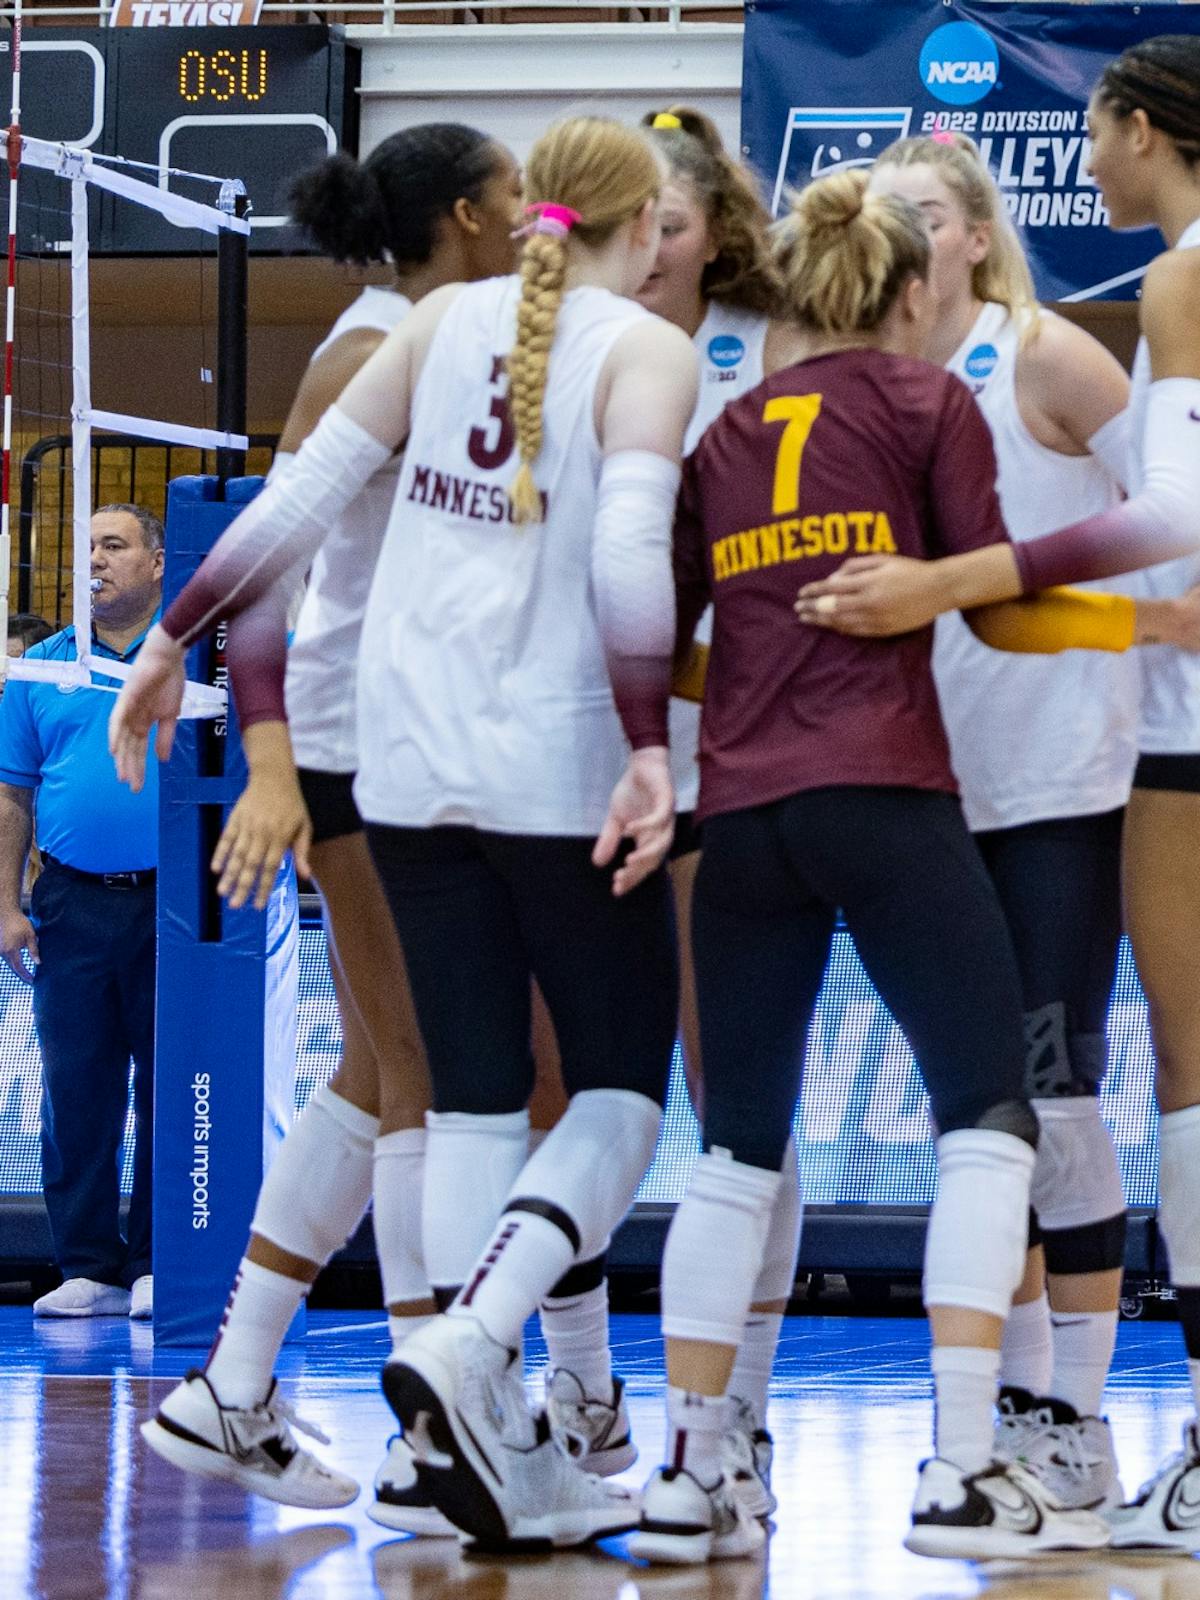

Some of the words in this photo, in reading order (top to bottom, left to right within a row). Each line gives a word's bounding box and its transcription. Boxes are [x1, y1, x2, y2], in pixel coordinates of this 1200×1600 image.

[178, 49, 267, 101] OSU
[926, 61, 997, 85] NCAA
[921, 111, 978, 132] 2022
[981, 110, 1077, 132] DIVISION
[762, 392, 823, 517] 7
[712, 510, 898, 582] MINNESOTA
[191, 1072, 212, 1141] sports
